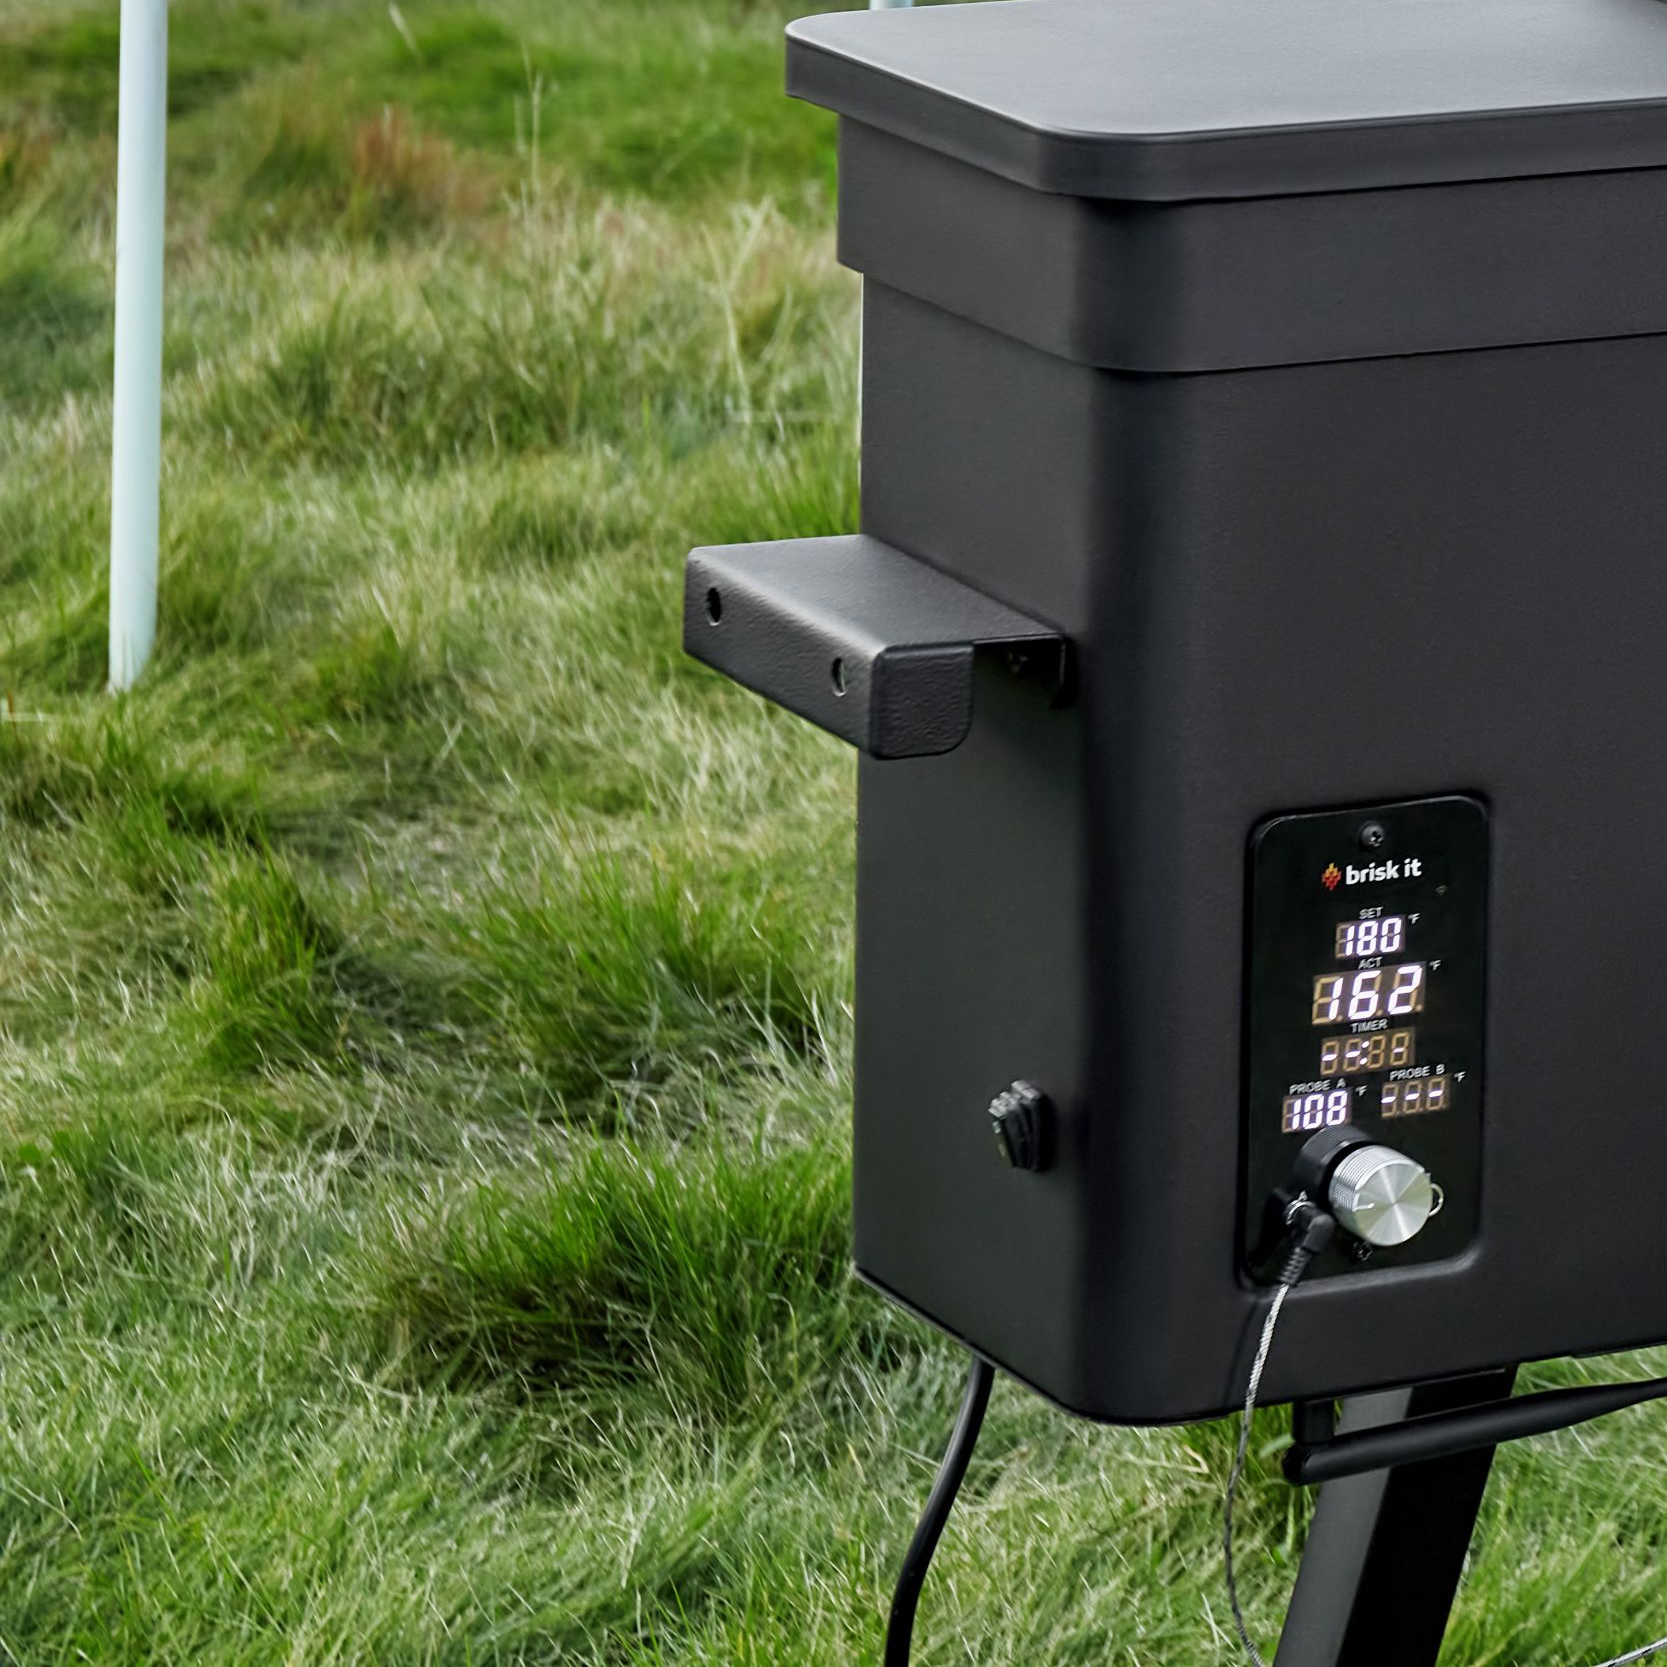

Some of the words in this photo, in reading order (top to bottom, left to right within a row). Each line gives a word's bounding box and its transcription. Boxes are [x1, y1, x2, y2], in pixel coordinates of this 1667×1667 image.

[1345, 860, 1400, 885] brisk
[1404, 858, 1422, 877] it
[1359, 906, 1383, 919] SET
[1345, 917, 1401, 956] 180
[1358, 956, 1383, 969] ACT
[1328, 965, 1422, 1021] 162
[1351, 1019, 1388, 1033] TIMER
[1390, 1066, 1430, 1081] PROBE
[1436, 1064, 1445, 1075] B
[1289, 1079, 1331, 1094] PROBE
[1336, 1078, 1346, 1088] A
[1292, 1090, 1348, 1130] 108
